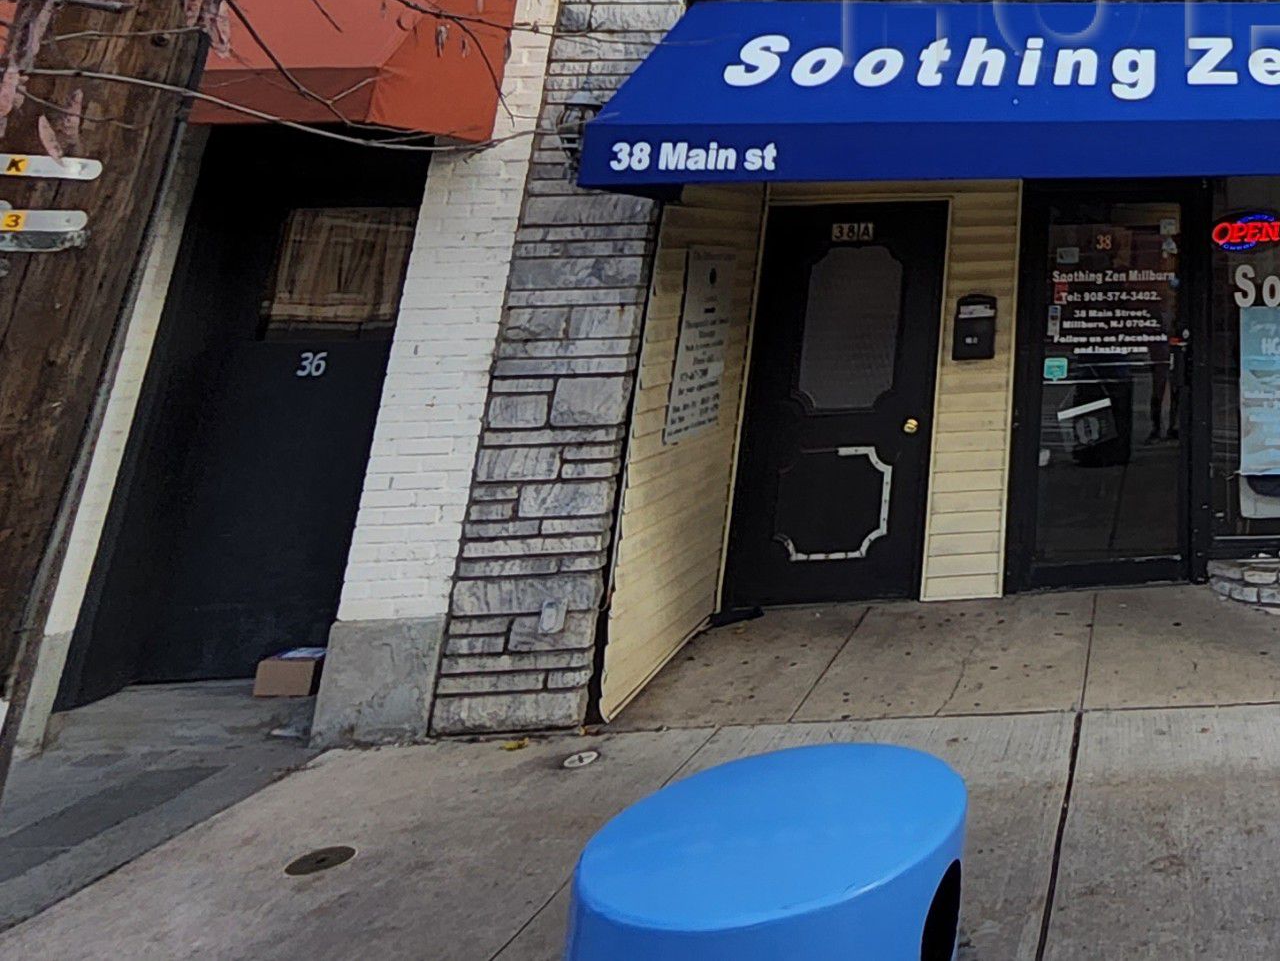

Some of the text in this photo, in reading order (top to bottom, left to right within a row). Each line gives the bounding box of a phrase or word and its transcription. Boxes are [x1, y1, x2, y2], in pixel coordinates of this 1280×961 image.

[723, 34, 1156, 100] Soothing
[609, 141, 778, 171] 38 Main st
[6, 158, 25, 172] K
[5, 214, 21, 228] 3
[1096, 234, 1112, 250] 38
[1052, 269, 1175, 284] Soothing Zen Millburn
[1061, 292, 1081, 302] Tel:
[1073, 309, 1086, 318] 38
[1088, 309, 1113, 317] Main
[1110, 319, 1124, 328] NJ
[1053, 334, 1087, 343] Follow
[1118, 333, 1168, 342] Facebook
[296, 351, 328, 377] 36
